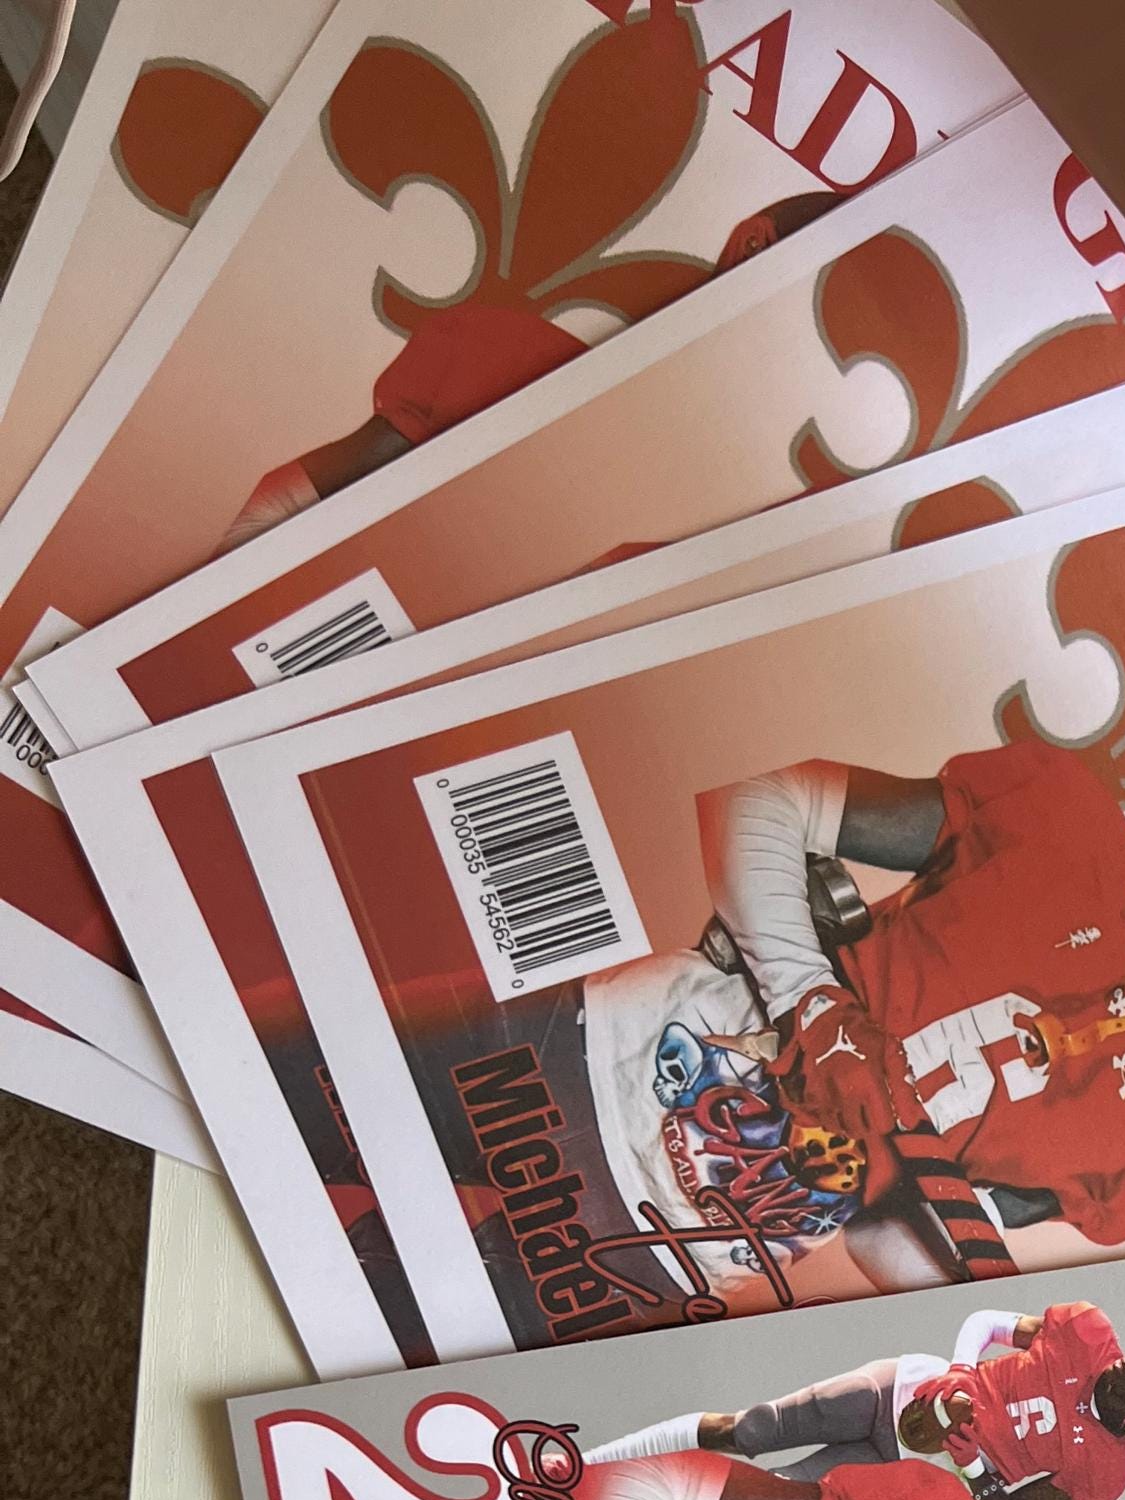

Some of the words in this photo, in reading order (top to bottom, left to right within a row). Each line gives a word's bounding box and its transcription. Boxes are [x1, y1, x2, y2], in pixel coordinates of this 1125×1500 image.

[449, 813, 487, 876] 00035
[479, 891, 516, 954] 54562
[450, 1044, 634, 1341] Michael
